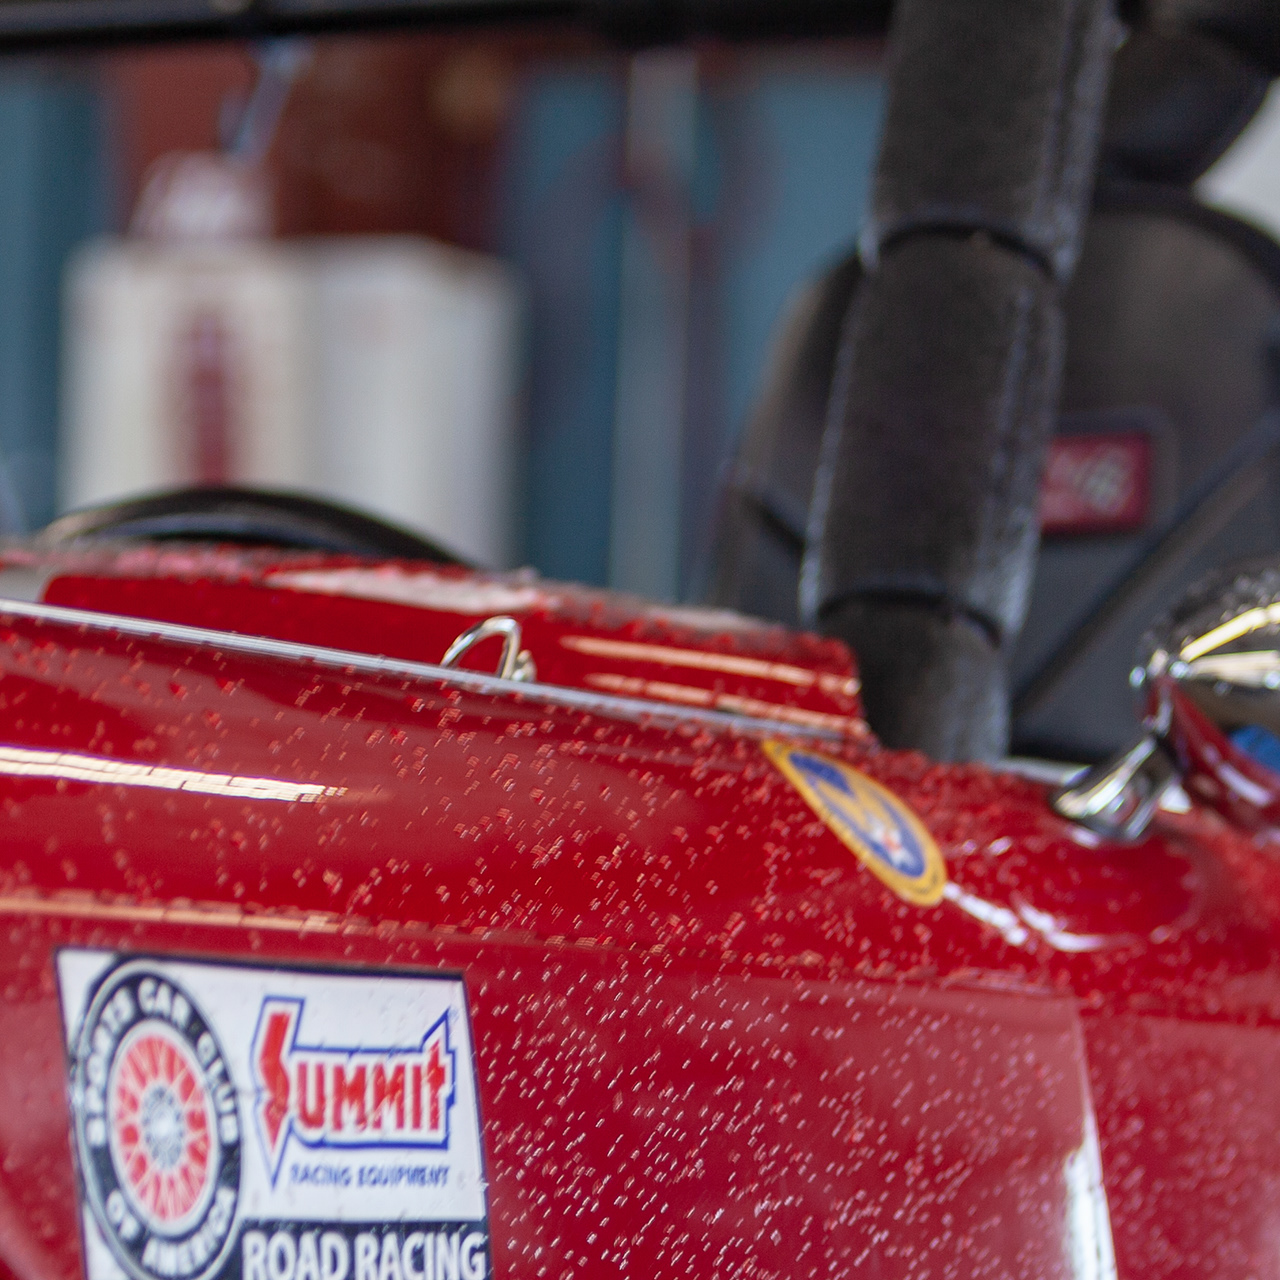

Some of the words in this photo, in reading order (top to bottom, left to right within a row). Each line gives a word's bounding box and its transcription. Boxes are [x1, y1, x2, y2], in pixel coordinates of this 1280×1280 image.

[85, 984, 134, 1146] SPORTS
[136, 977, 191, 1031] CAR
[196, 1030, 239, 1145] CLUB
[291, 1163, 352, 1187] RACING
[356, 1164, 450, 1189] EQUIPMENT
[105, 1188, 140, 1241] OF
[140, 1186, 237, 1277] AMERICA
